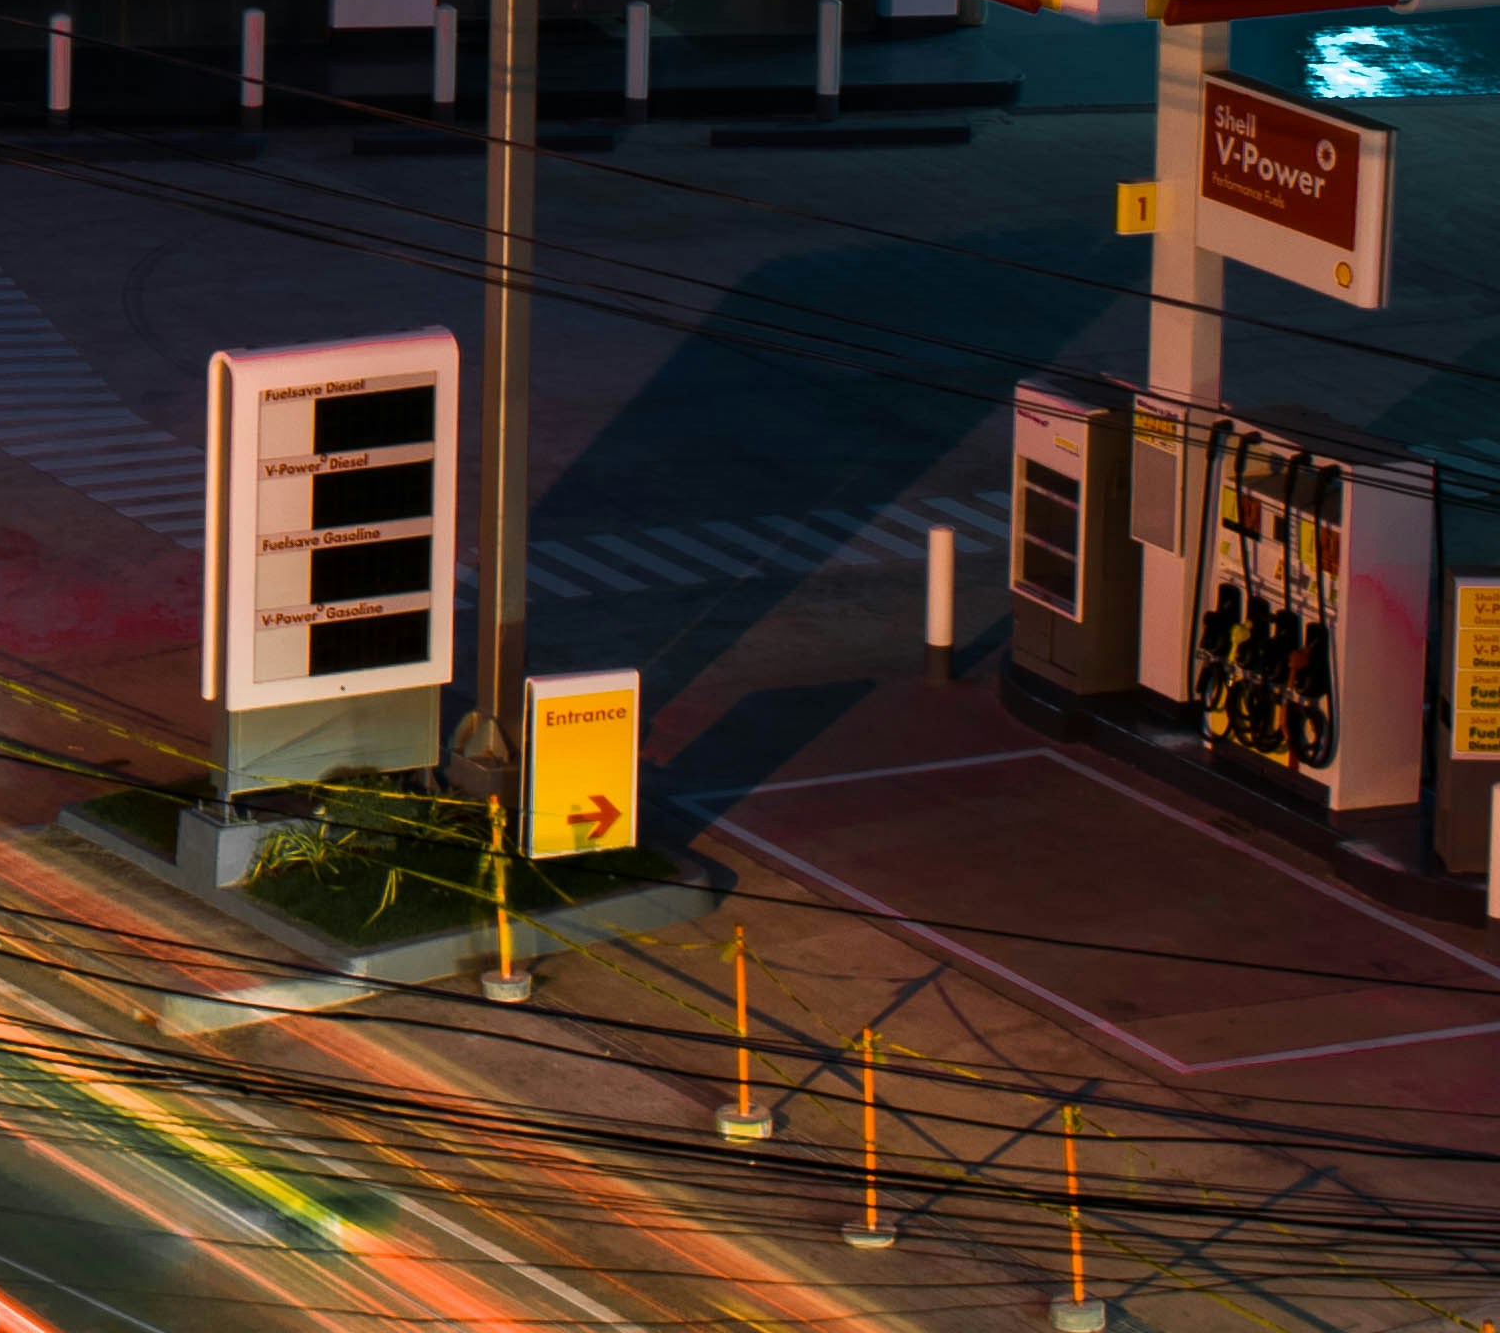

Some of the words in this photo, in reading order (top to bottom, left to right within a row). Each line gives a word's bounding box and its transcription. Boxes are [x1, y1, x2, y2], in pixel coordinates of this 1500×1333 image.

[1213, 103, 1256, 139] Shell
[1214, 131, 1326, 199] V-Power
[1211, 170, 1264, 202] Performance
[1264, 189, 1285, 210] Fuels
[1137, 196, 1147, 221] 1
[265, 385, 322, 401] Fuelsave
[326, 379, 366, 393] Diesel
[265, 462, 321, 477] V-Power
[329, 453, 369, 470] Diesel
[262, 535, 320, 551] Fuelsave
[323, 528, 381, 544] Gasoline
[262, 611, 317, 627] V-Power
[326, 603, 383, 619] Gasoline
[545, 707, 628, 726] Entrance
